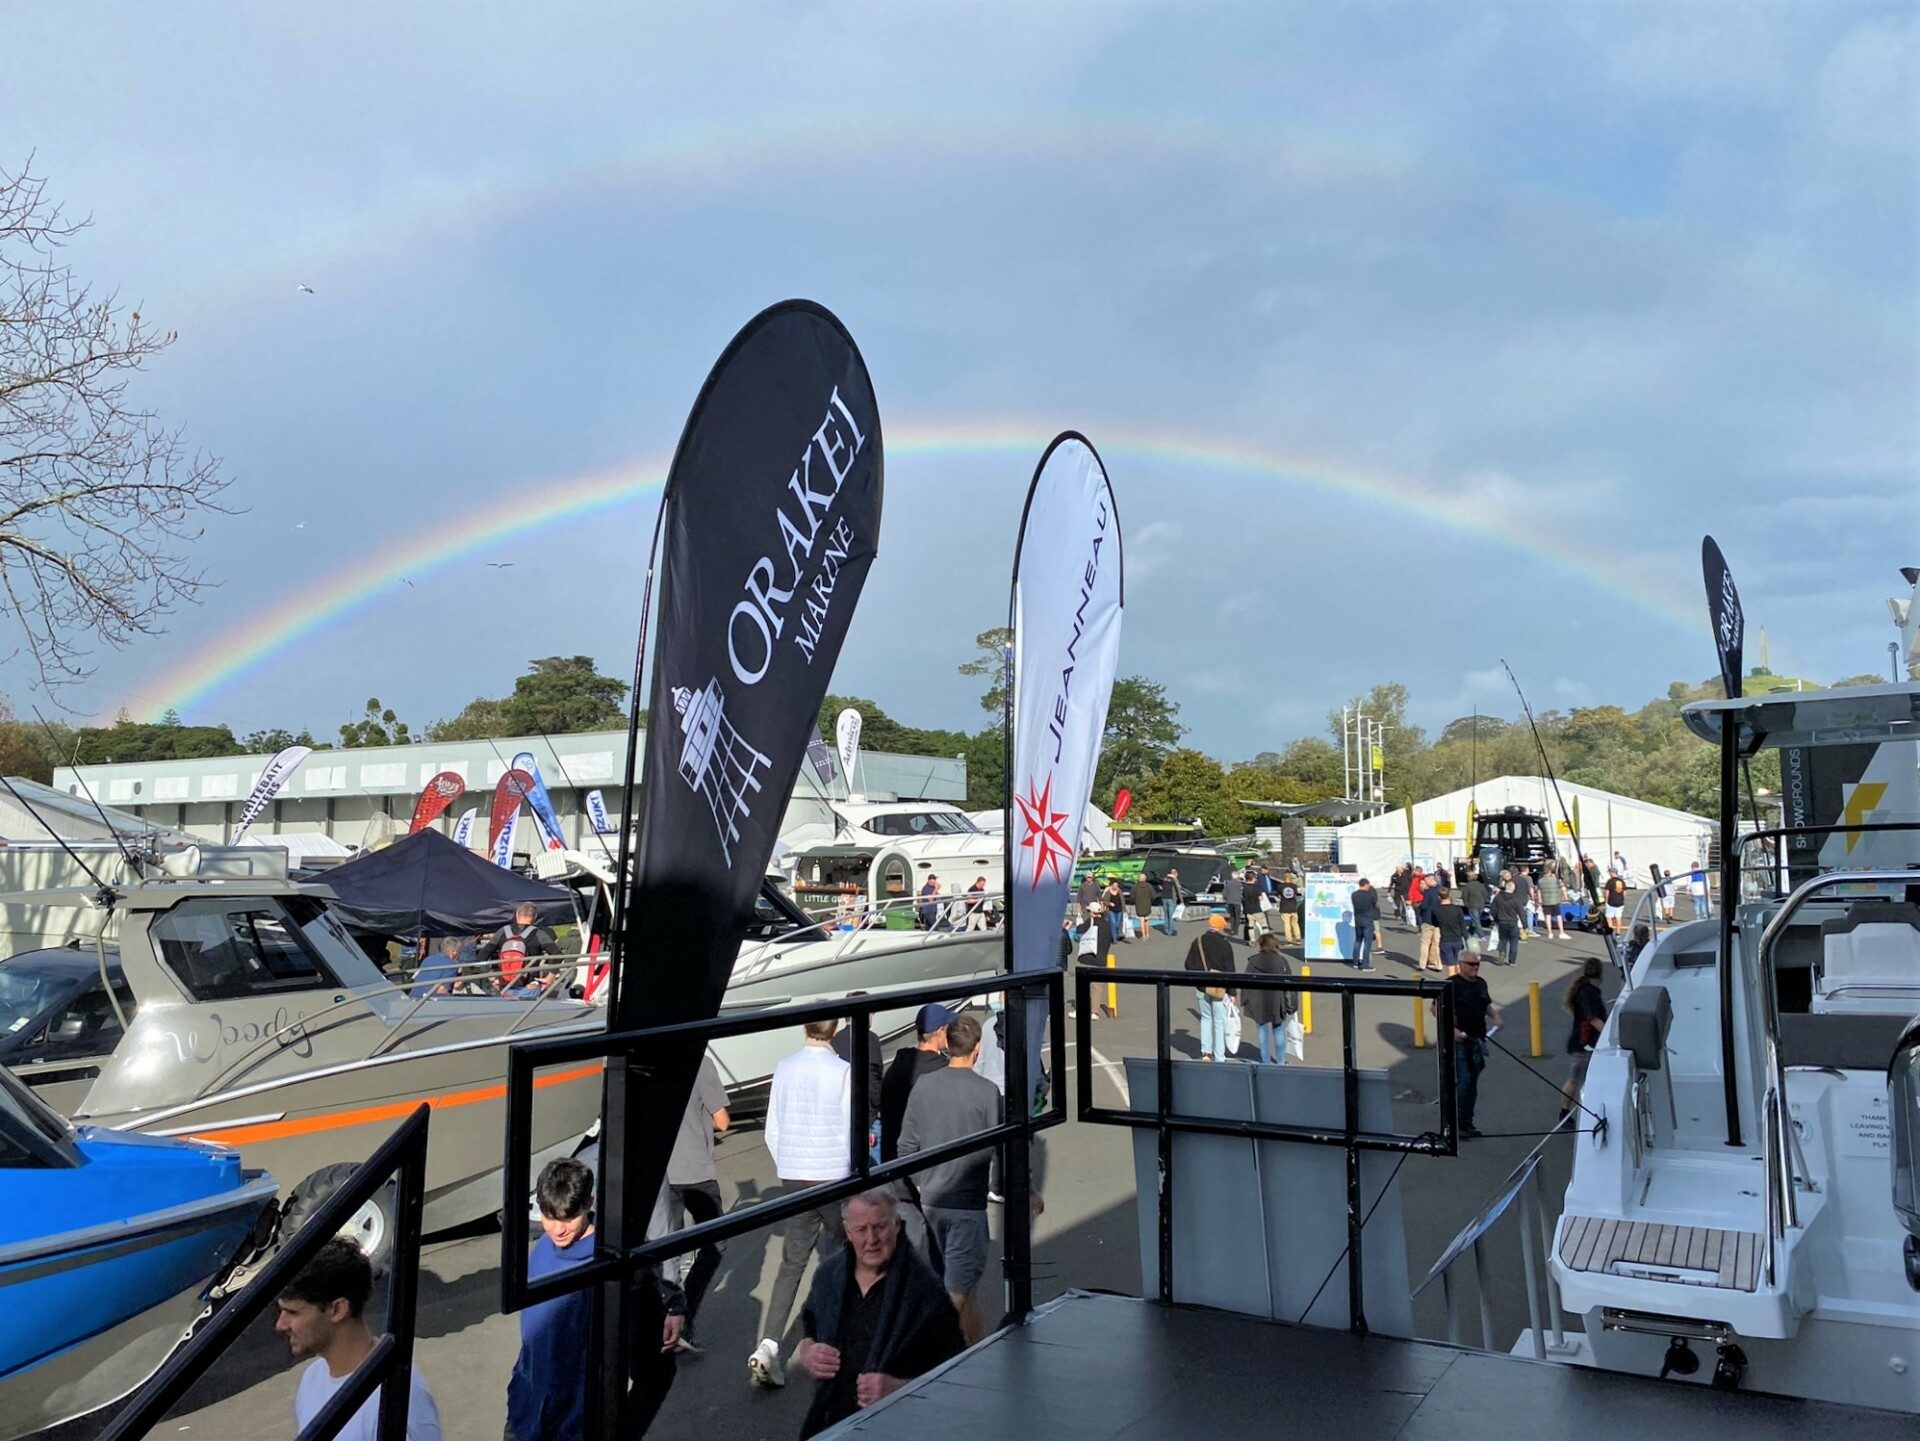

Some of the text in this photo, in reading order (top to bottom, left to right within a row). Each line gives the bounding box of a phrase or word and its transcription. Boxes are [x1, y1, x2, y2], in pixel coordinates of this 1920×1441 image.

[728, 385, 866, 685] ORAKEI
[795, 516, 854, 665] MARINE
[1049, 502, 1107, 764] JEANNEAU
[239, 762, 283, 824] WHITEBAIT
[1789, 748, 1807, 849] SHOWGROUNDS
[804, 895, 830, 903] LITTLE
[162, 1006, 317, 1063] Woody
